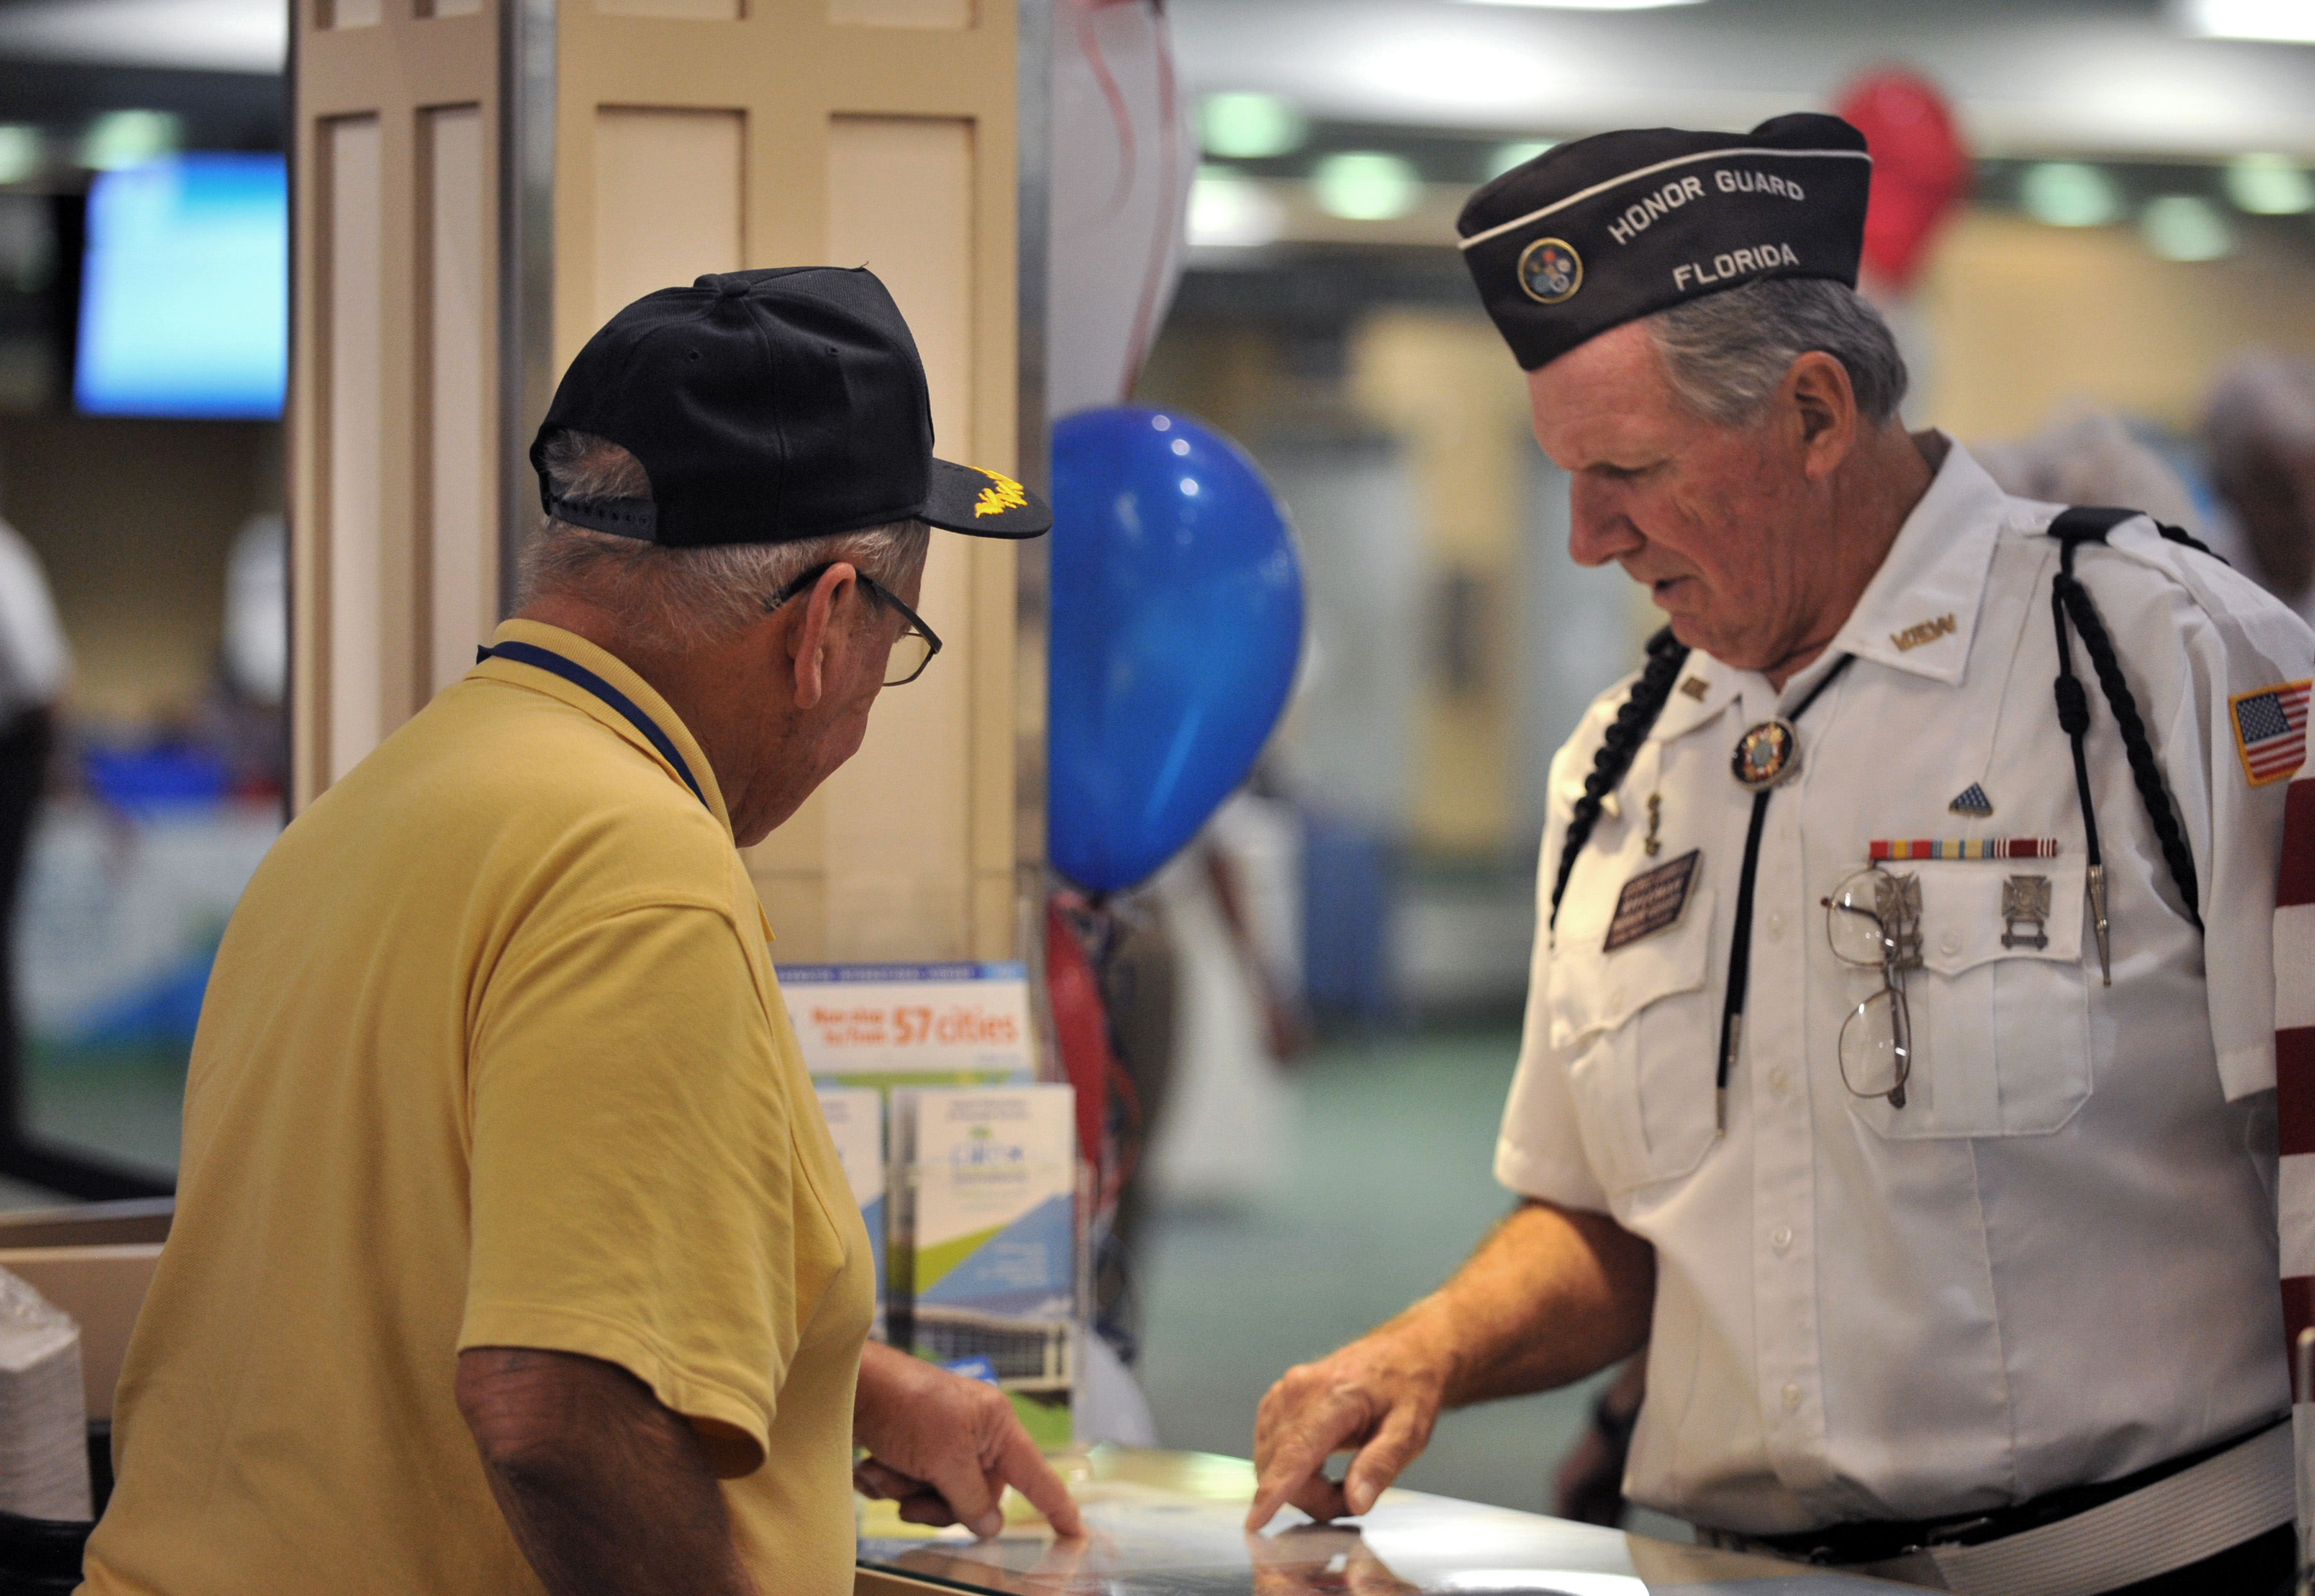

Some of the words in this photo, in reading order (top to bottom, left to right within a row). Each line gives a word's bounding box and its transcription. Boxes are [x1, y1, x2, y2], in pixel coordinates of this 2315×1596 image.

[1607, 176, 1705, 245] HONOR
[1714, 169, 1804, 201] GUARD
[1672, 242, 1800, 291] FLORIDA
[894, 1006, 933, 1046] 57
[936, 1005, 1019, 1046] cities
